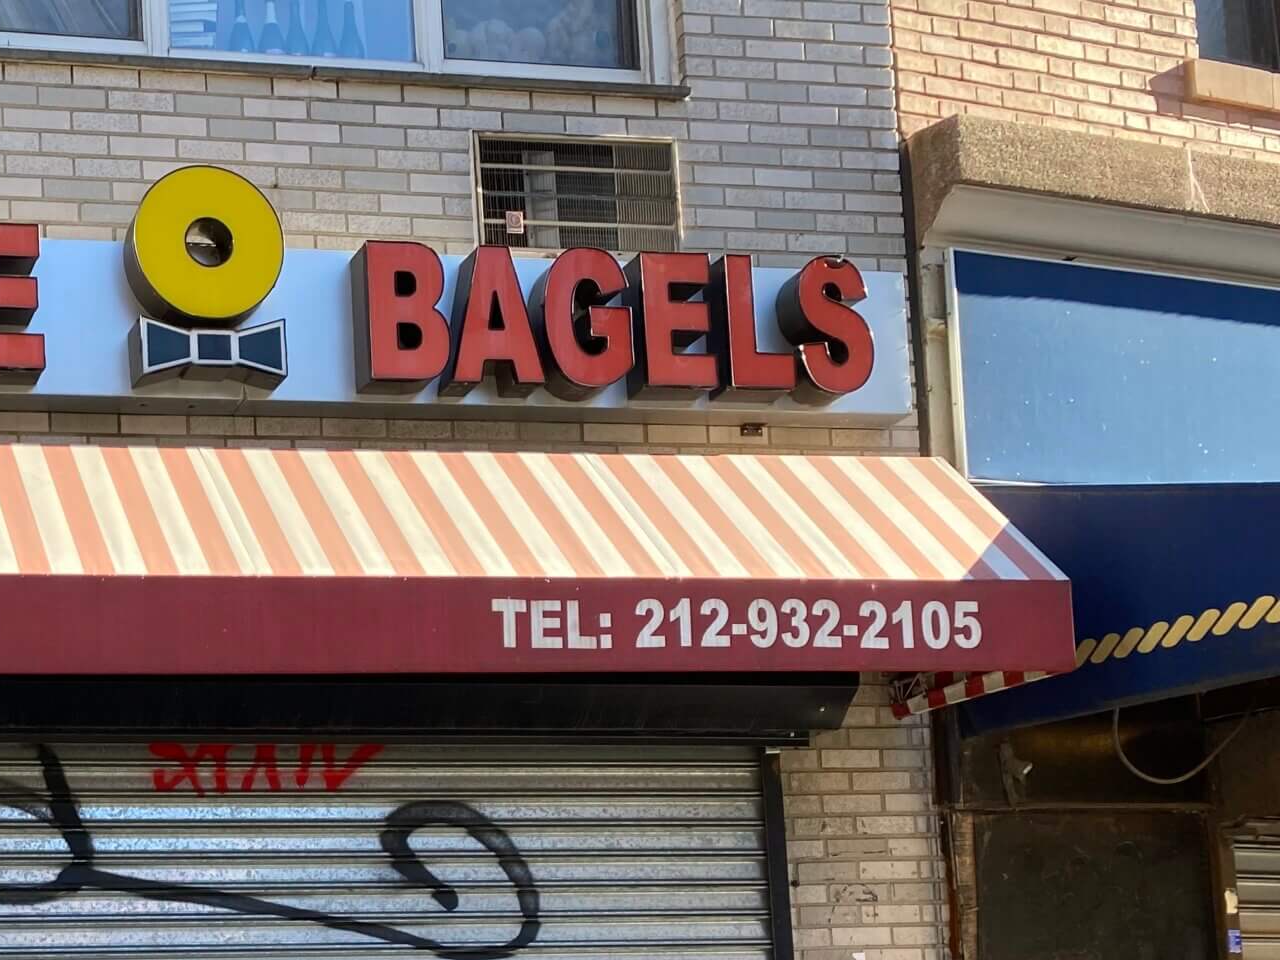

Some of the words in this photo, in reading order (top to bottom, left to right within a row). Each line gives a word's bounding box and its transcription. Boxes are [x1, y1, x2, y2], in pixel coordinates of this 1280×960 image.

[358, 239, 875, 393] BAGELS
[491, 598, 613, 650] TEL:
[634, 597, 983, 651] 212-932-2105
